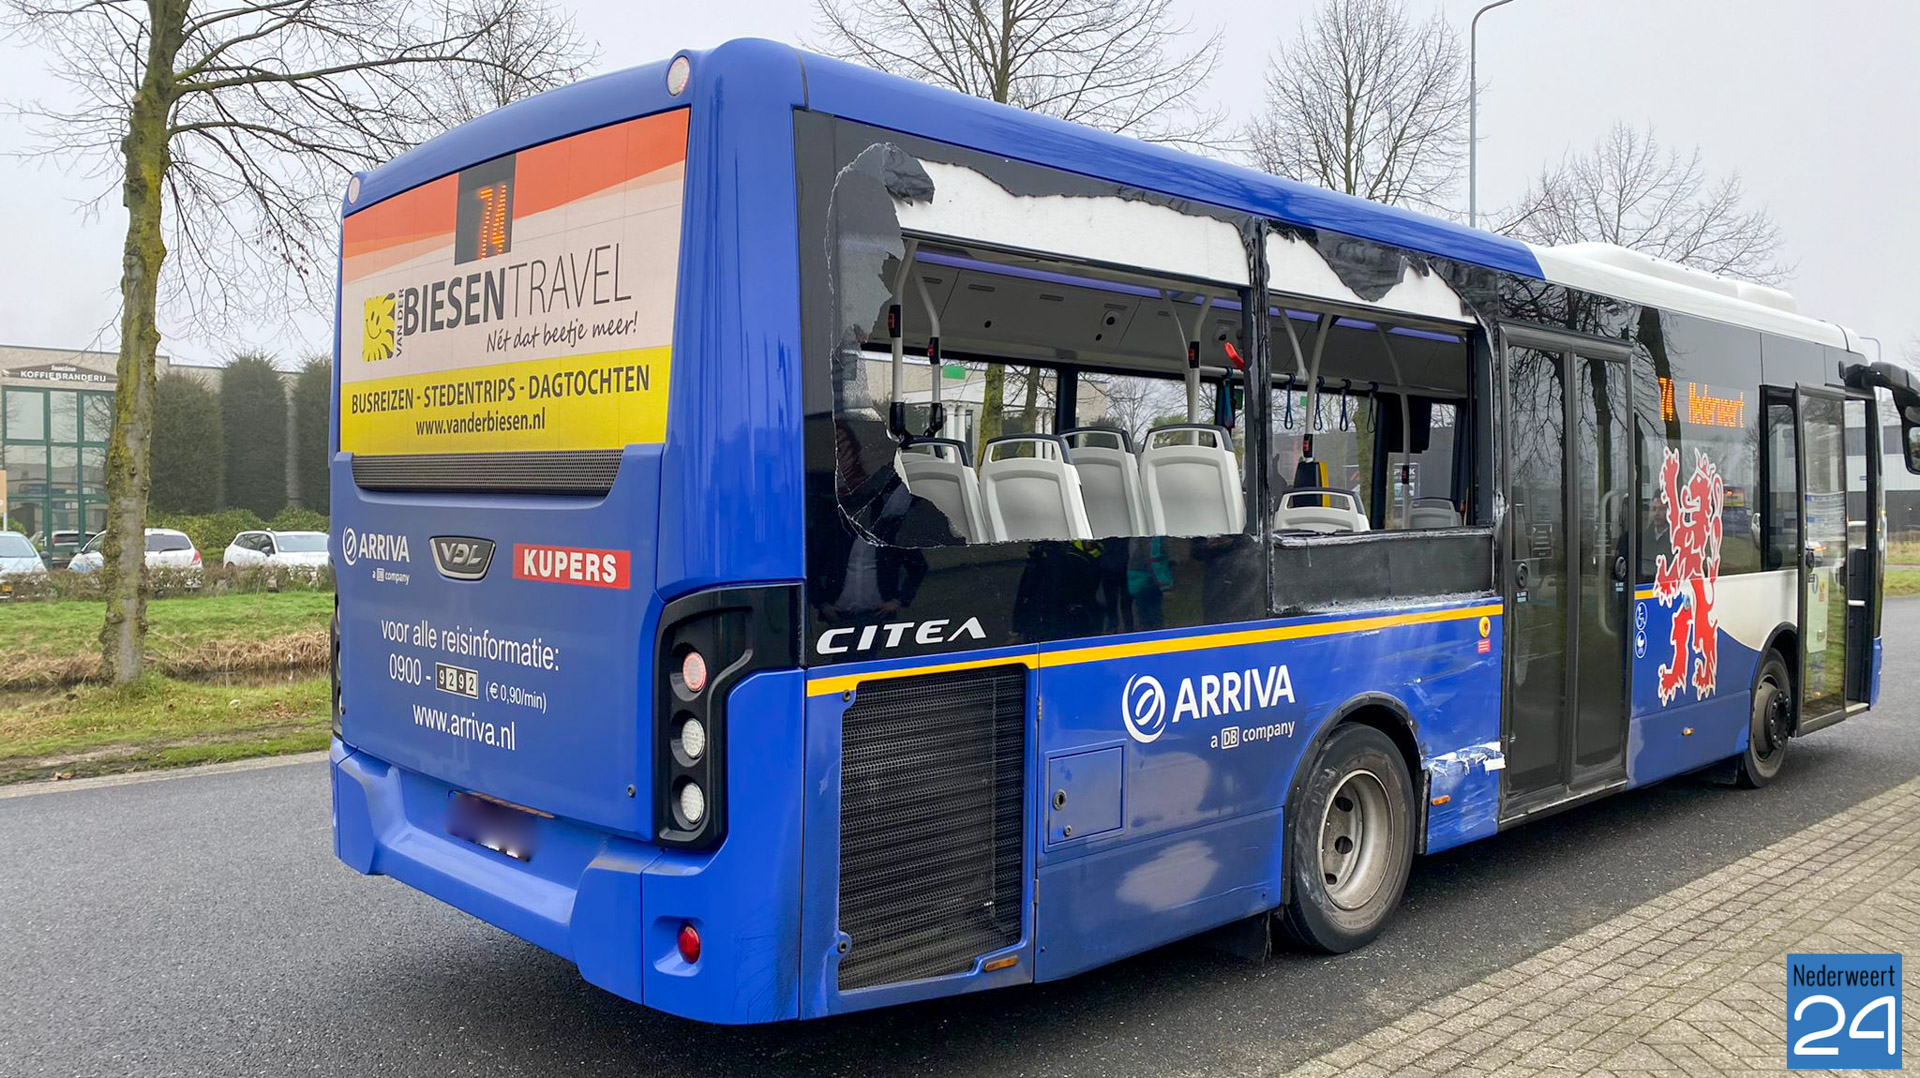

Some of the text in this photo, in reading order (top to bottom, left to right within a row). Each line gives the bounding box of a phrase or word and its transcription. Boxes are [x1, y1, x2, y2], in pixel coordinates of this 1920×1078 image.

[479, 183, 506, 260] 74
[486, 311, 638, 353] Nét dat beetje meer!
[20, 370, 107, 382] KOFFIEBRANDERIJ
[352, 388, 414, 414] BUSREIZEN
[424, 377, 516, 408] STEDENTRIPS
[528, 364, 650, 400] DAGTOCHTEN
[415, 407, 546, 436] www.vanderbiesen.nl
[1689, 382, 1744, 428] Nederweert
[358, 532, 410, 563] ARRIVA
[440, 542, 482, 566] VDL
[523, 548, 617, 584] KUPERS
[385, 571, 410, 586] company
[381, 619, 559, 671] voor alle reisinformatie:
[816, 616, 988, 655] CITEA
[389, 653, 422, 686] 0900
[438, 669, 475, 692] 9292
[1172, 664, 1296, 723] ARRIVA
[412, 704, 516, 751] www.arriva.nl
[1210, 720, 1296, 748] a DB company
